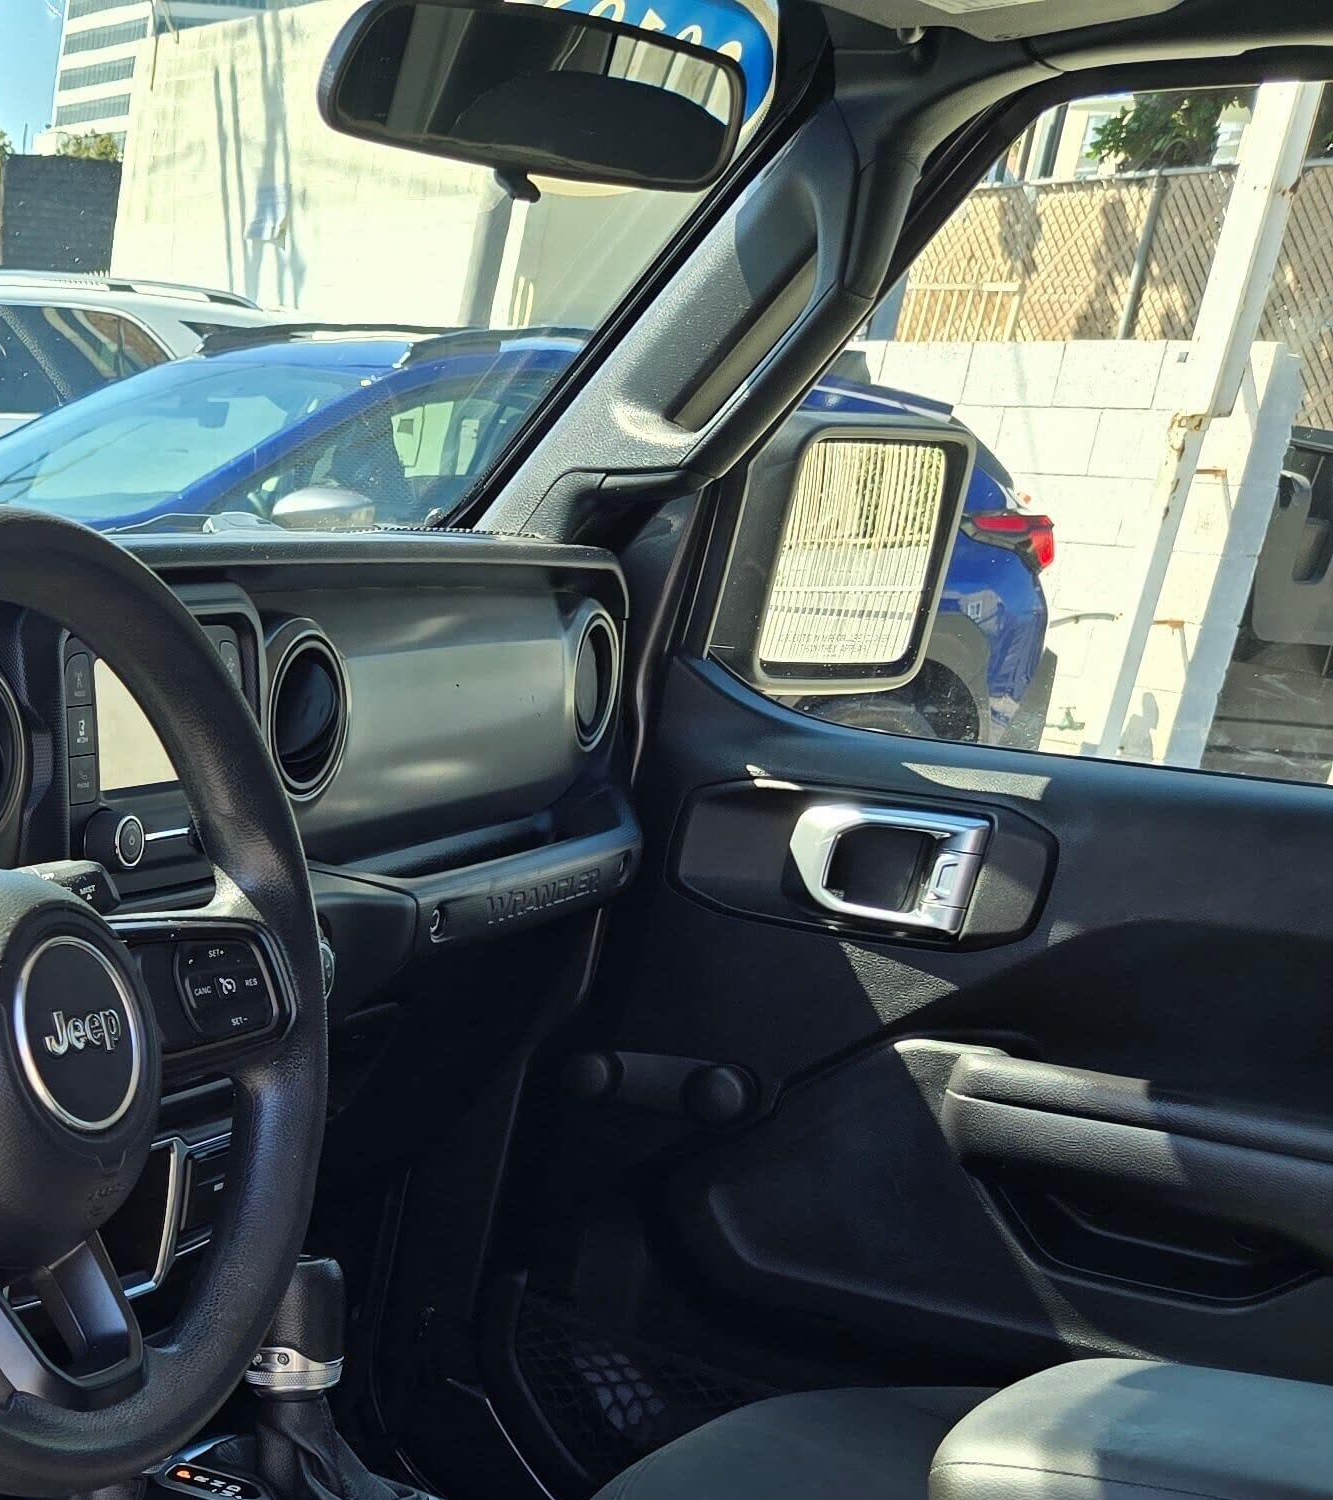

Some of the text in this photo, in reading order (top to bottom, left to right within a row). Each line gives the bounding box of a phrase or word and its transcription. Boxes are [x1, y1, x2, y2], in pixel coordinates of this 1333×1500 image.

[485, 868, 601, 925] WRANGLER
[194, 986, 212, 996] CANC
[244, 977, 258, 987] RES
[44, 1008, 122, 1056] Jeep
